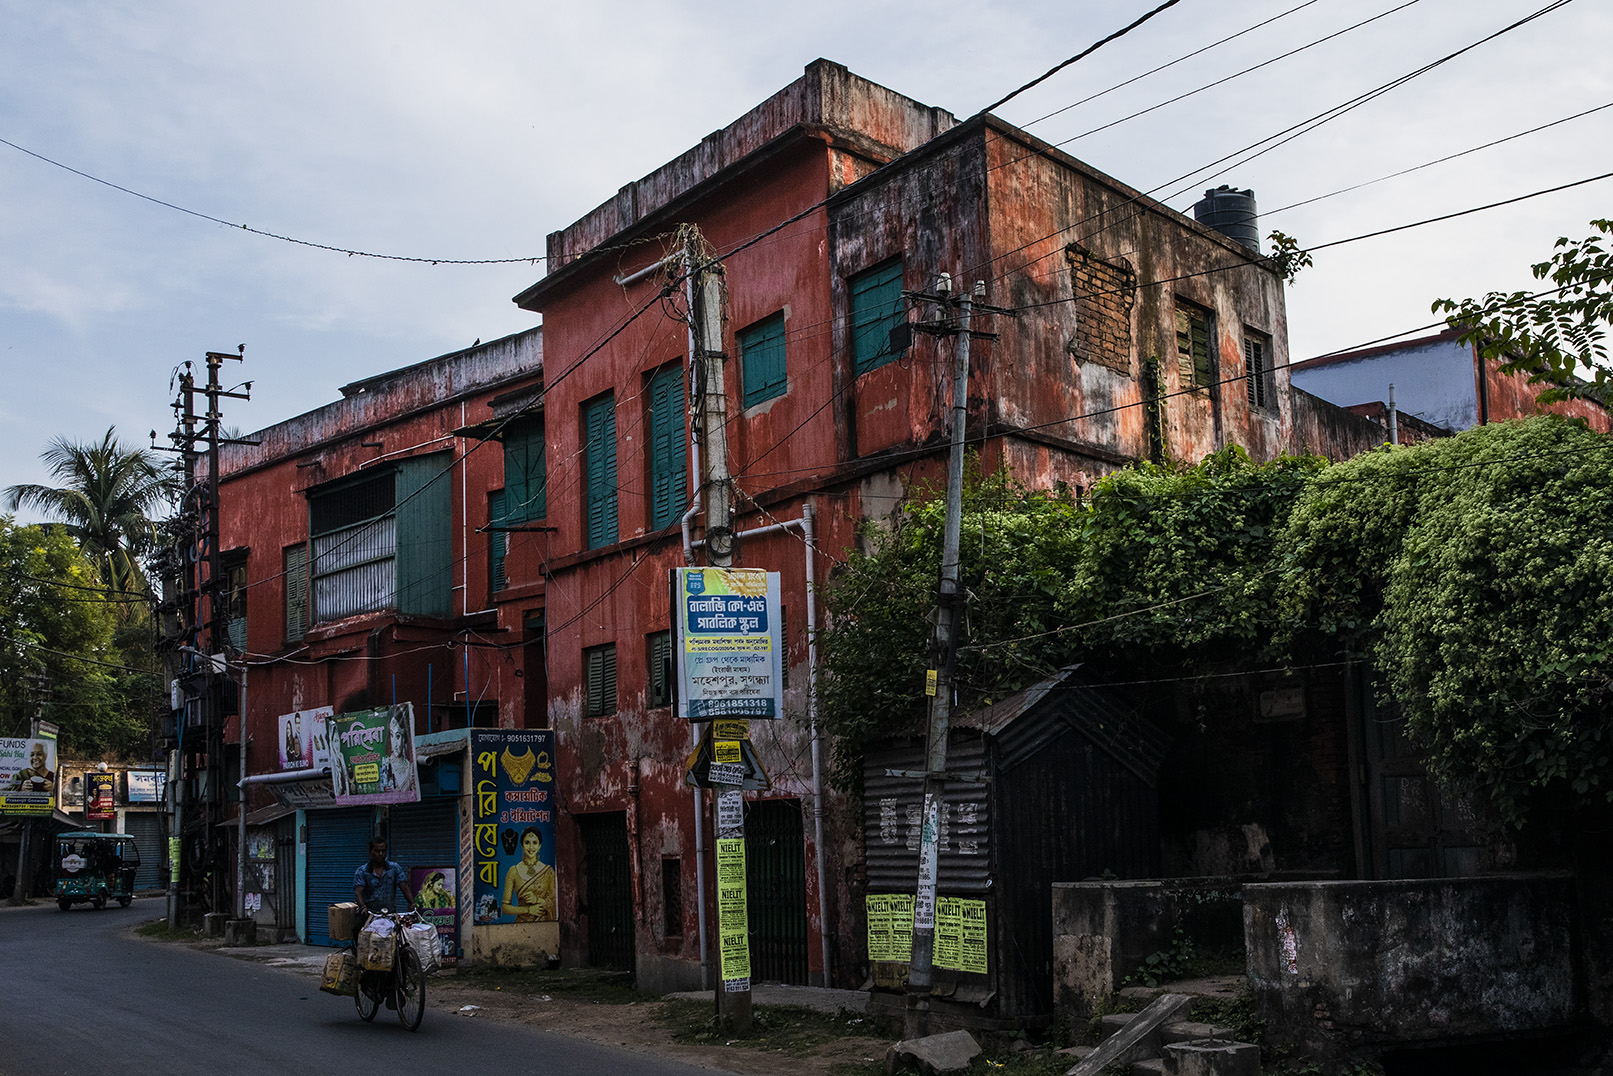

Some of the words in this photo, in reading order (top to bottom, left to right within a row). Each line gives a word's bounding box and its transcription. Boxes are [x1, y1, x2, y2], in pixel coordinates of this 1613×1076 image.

[689, 597, 726, 612] বালাজি
[697, 613, 737, 629] পাবলিক
[739, 617, 759, 634] স্কুল
[720, 656, 738, 664] থেকে
[691, 675, 738, 688] মহেশপুর,
[708, 700, 767, 708] 8961851318
[340, 721, 385, 751] পরিষেবা
[506, 734, 546, 743] 9051631797
[504, 787, 548, 802] কসমেটিক
[501, 811, 509, 823] ও
[510, 807, 550, 823] ইমিটেশন
[720, 843, 741, 853] NIELIT
[721, 890, 743, 900] NIELIT
[894, 901, 912, 912] NIELIT
[941, 904, 961, 917] NIELIT
[966, 908, 985, 920] NIELIT
[723, 935, 744, 946] NIELIT
